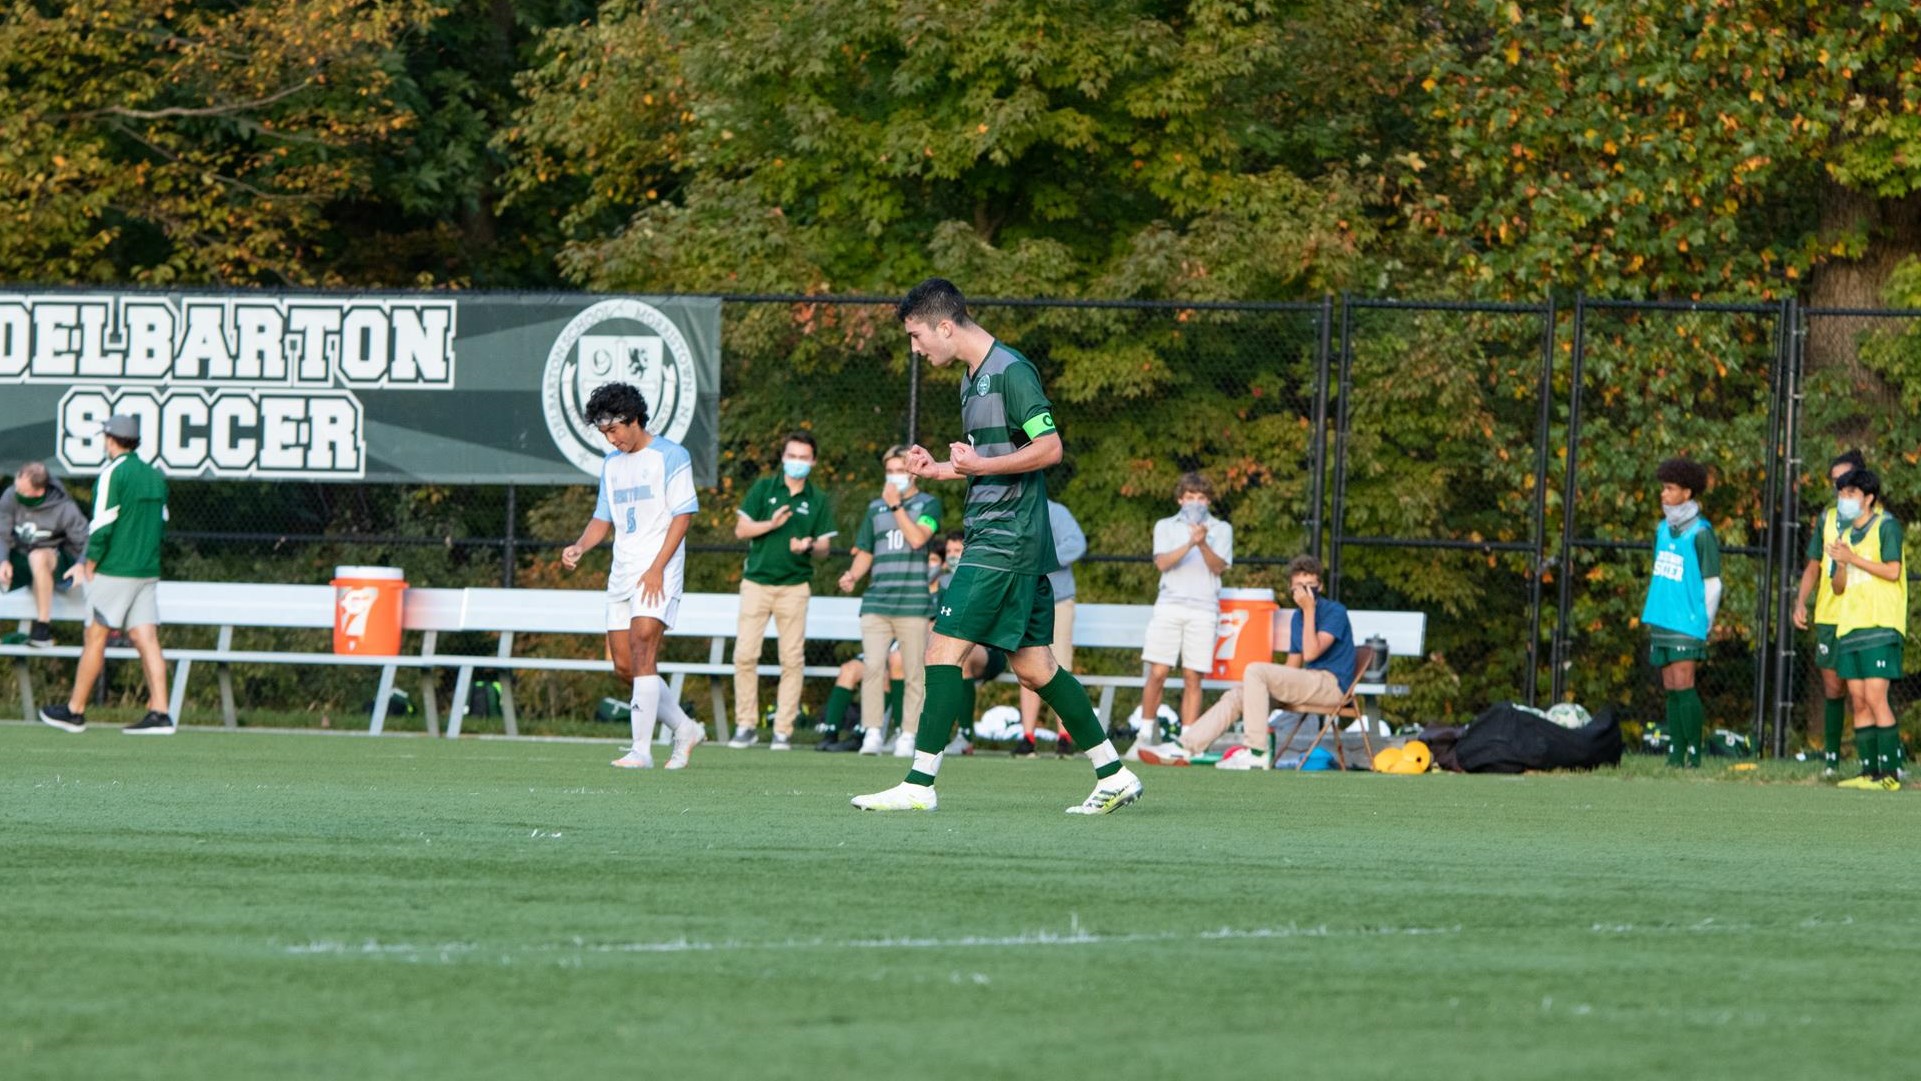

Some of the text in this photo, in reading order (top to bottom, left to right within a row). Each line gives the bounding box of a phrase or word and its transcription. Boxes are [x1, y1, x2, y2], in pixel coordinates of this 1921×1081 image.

[0, 298, 455, 387] DELBARTON
[546, 305, 611, 441] DELBARTON SCHOOL
[635, 304, 692, 393] MORRISTOWN
[885, 529, 904, 551] 10
